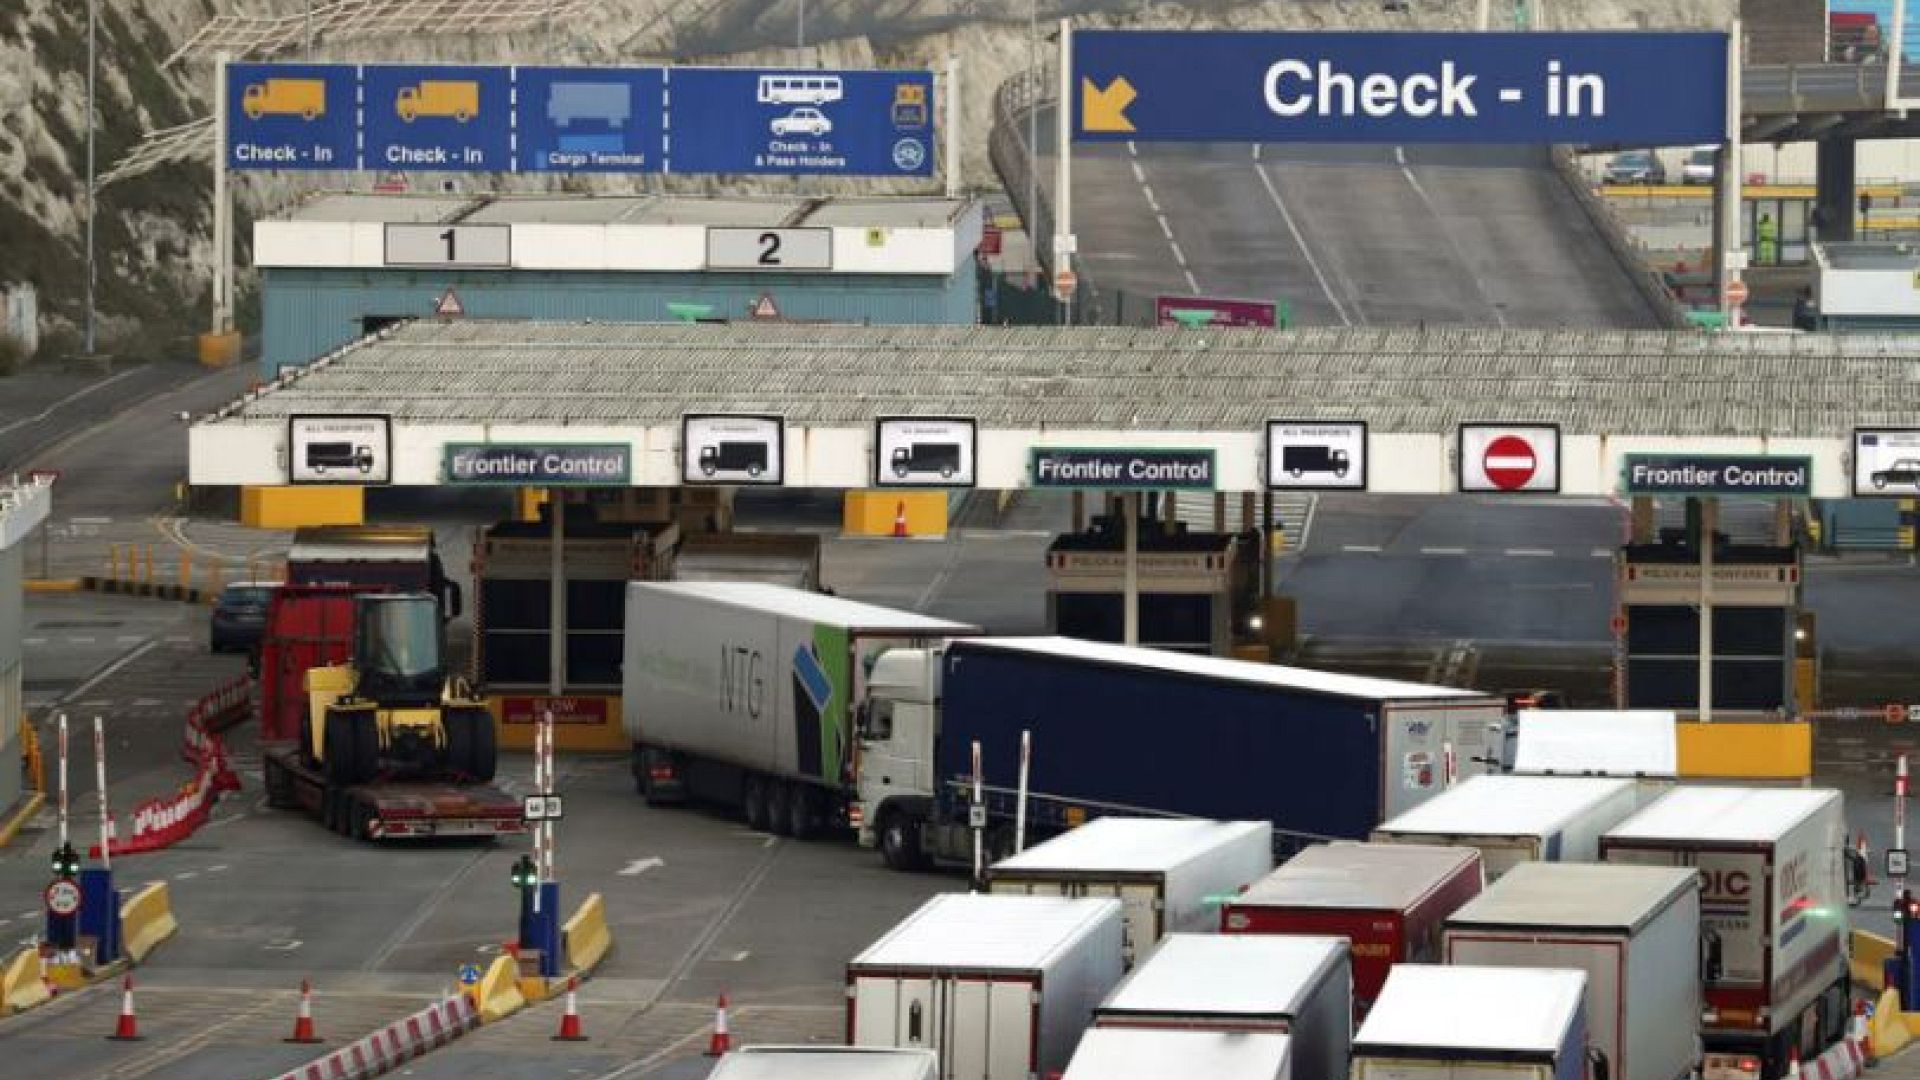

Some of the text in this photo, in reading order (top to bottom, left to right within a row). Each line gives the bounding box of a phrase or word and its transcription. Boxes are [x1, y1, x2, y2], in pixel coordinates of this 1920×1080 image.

[1264, 59, 1478, 116] Check
[1546, 60, 1604, 116] in
[236, 144, 297, 161] Check
[314, 145, 333, 161] In
[386, 145, 446, 163] Check
[464, 146, 484, 163] In
[769, 141, 808, 152] Check
[549, 151, 645, 166] Cargo Terminal
[440, 229, 455, 260] 1
[758, 233, 781, 265] 2
[453, 453, 624, 475] Frontier Control
[1038, 458, 1208, 480] Frontier Control
[1632, 465, 1805, 487] Frontier Control
[719, 637, 763, 720] NTG
